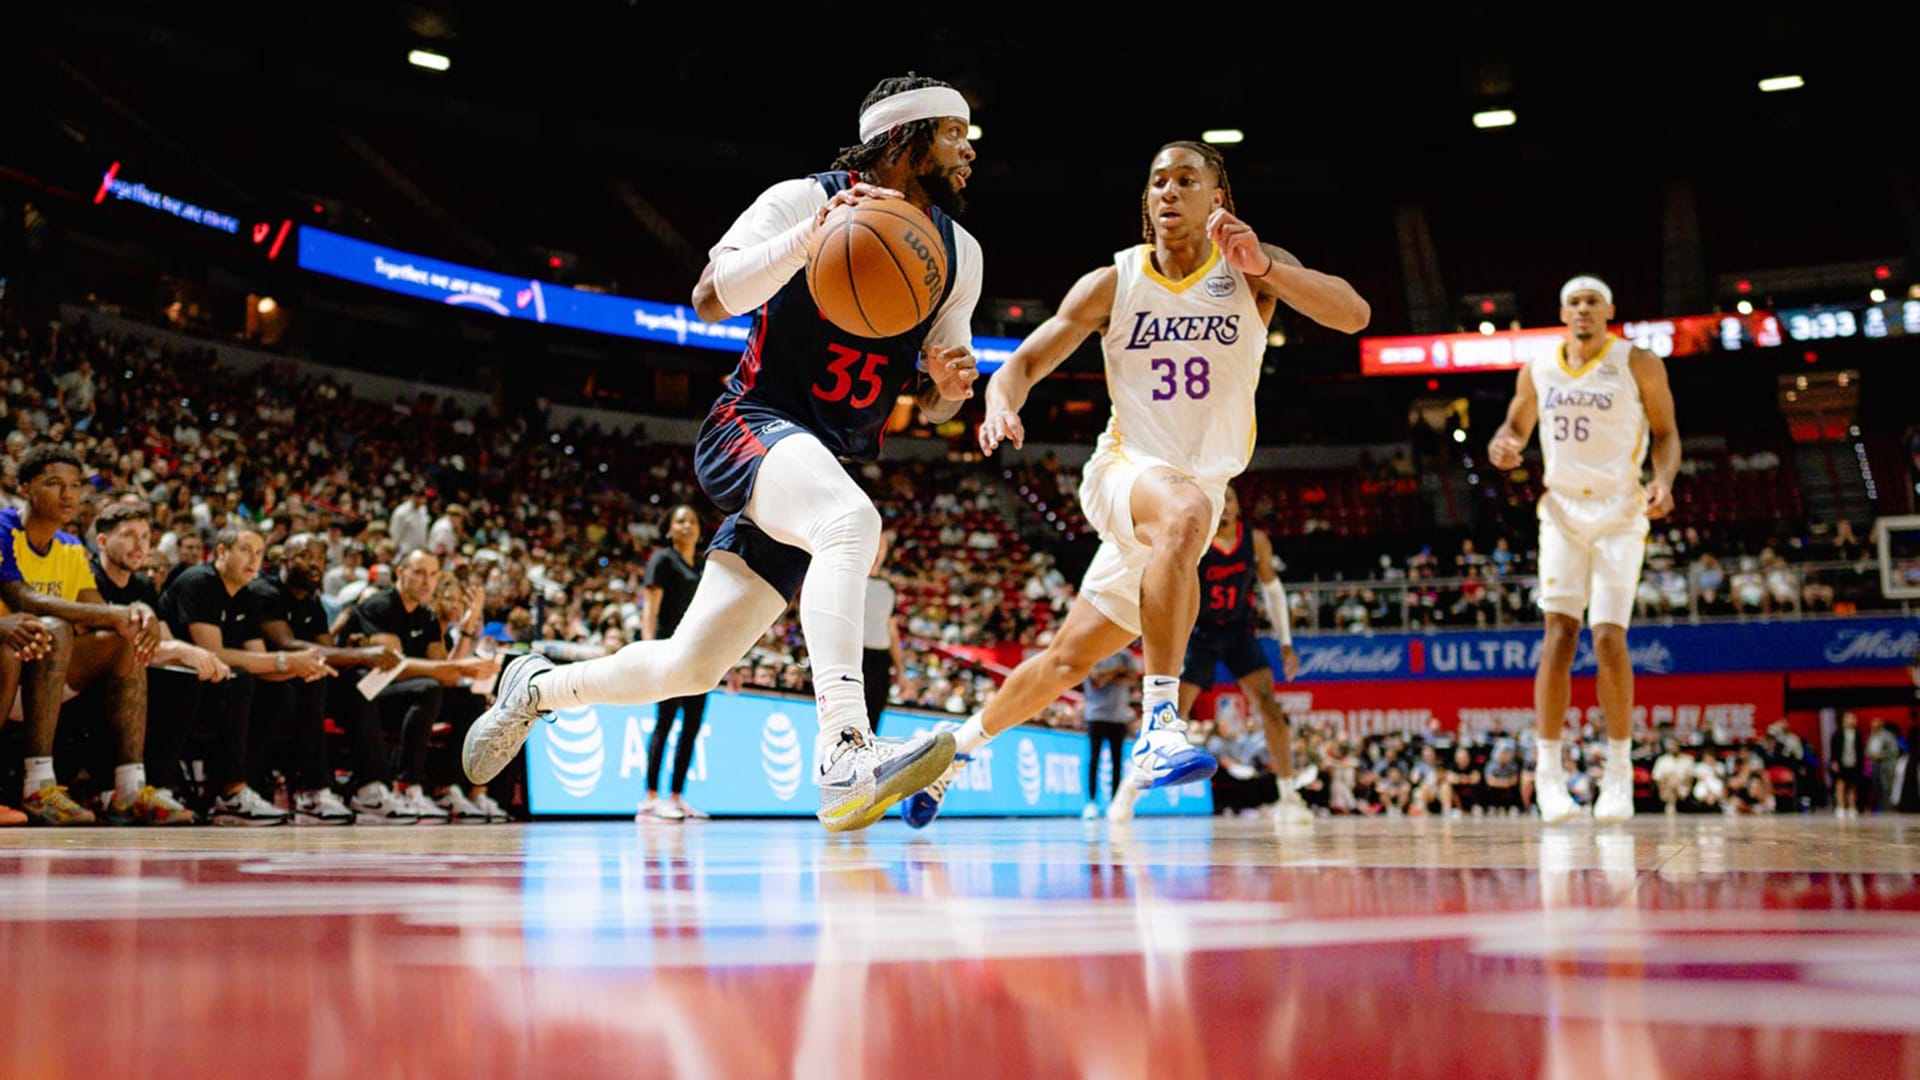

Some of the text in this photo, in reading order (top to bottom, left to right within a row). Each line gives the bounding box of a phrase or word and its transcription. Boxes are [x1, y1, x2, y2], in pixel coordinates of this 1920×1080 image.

[1125, 311, 1240, 350] LAKERS
[1790, 311, 1857, 340] 3:33
[811, 342, 888, 410] 35
[1151, 356, 1210, 401] 38
[1545, 387, 1613, 410] LAKERS
[1554, 416, 1590, 441] 36
[31, 581, 63, 597] KERS
[1209, 585, 1237, 609] 51
[620, 716, 711, 781] AT
